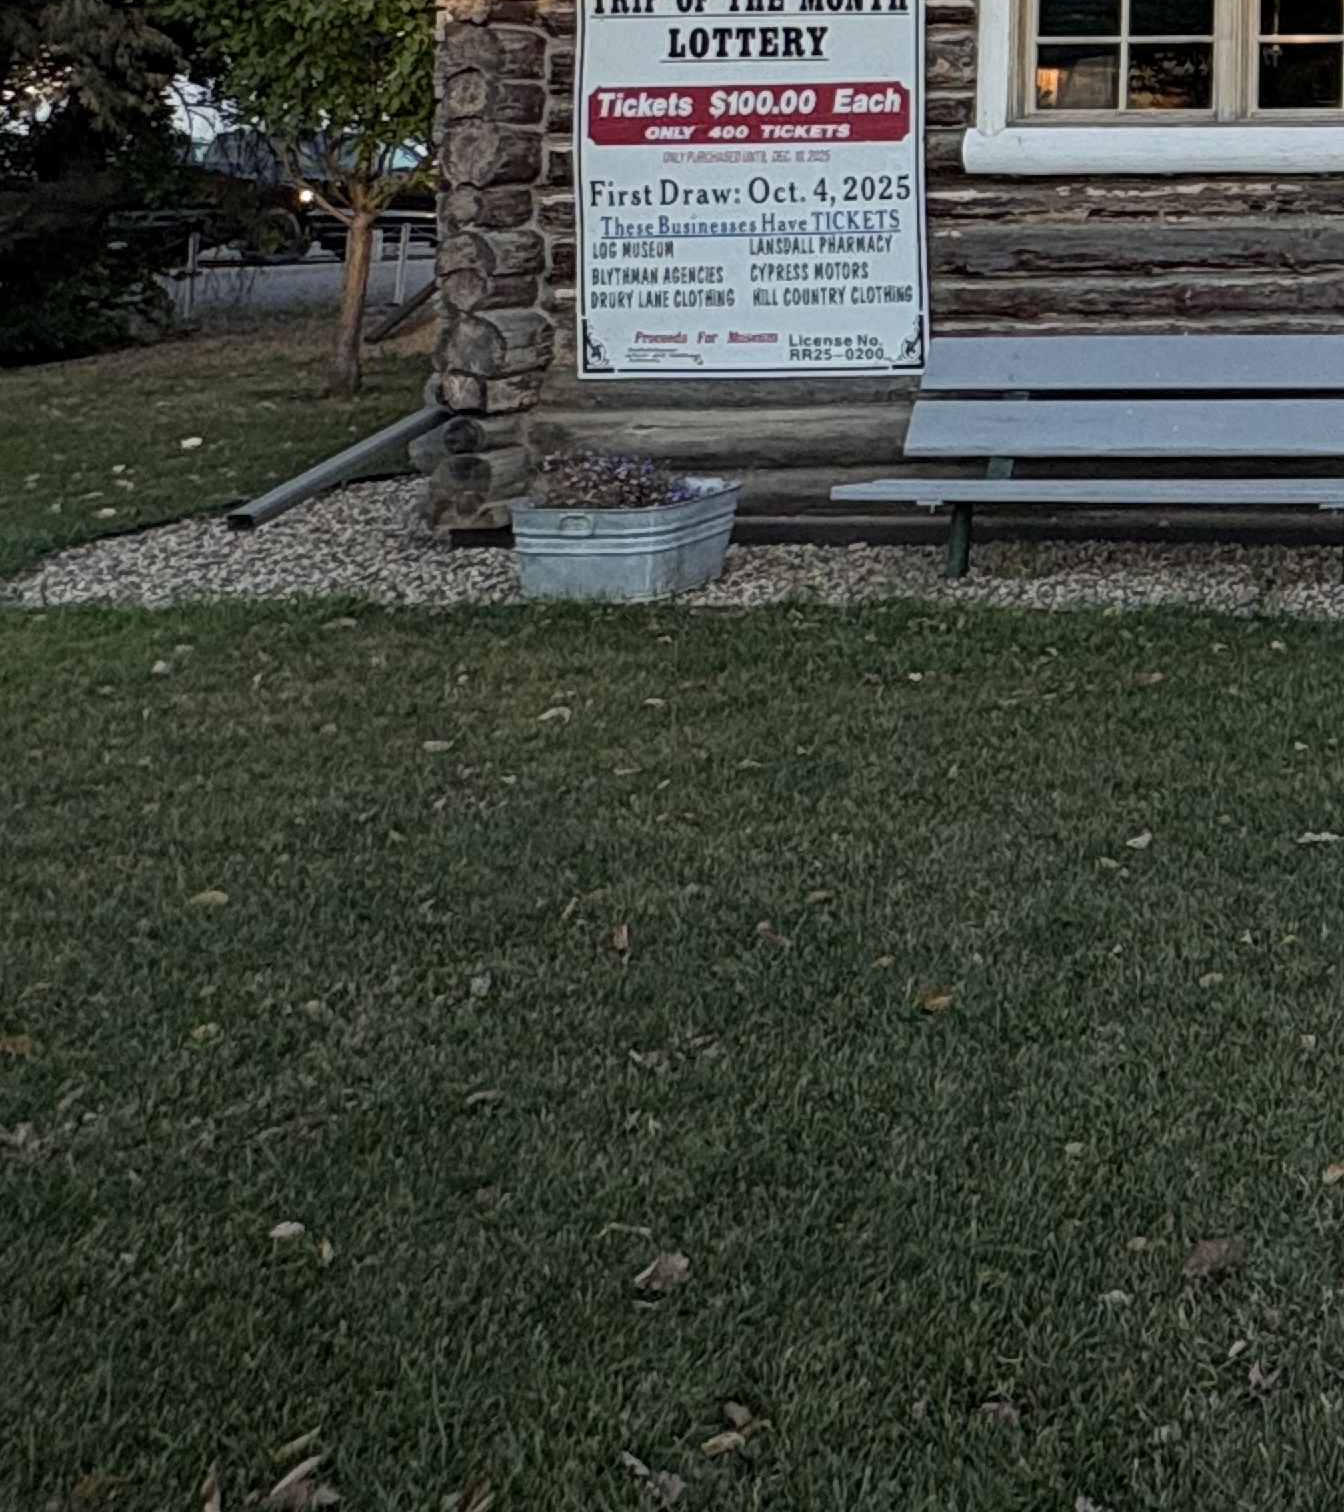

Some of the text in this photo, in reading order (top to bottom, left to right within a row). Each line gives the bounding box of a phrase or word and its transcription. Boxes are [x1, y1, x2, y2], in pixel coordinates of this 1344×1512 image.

[668, 26, 829, 58] LOTTERY
[597, 88, 902, 119] Tickets $100.00 Each
[645, 123, 852, 140] ONLY 400 TICKETS
[590, 174, 911, 207] First Draw: Oct. 4, 2025
[601, 209, 900, 236] These Businesses Have TICKETS
[592, 241, 674, 259] LOG MUSEUM
[749, 235, 893, 255] LANSDALL PHARMACY
[592, 266, 724, 285] BLYTHMAN AGENCIES
[750, 261, 869, 282] CYPRESS MOTORS
[591, 288, 735, 309] DRURY LANE CLOTHING
[753, 285, 914, 306] HILL COUNTRY CLOTHING
[697, 331, 719, 344] For
[788, 333, 883, 348] License No.
[789, 348, 885, 361] RR25-0200
